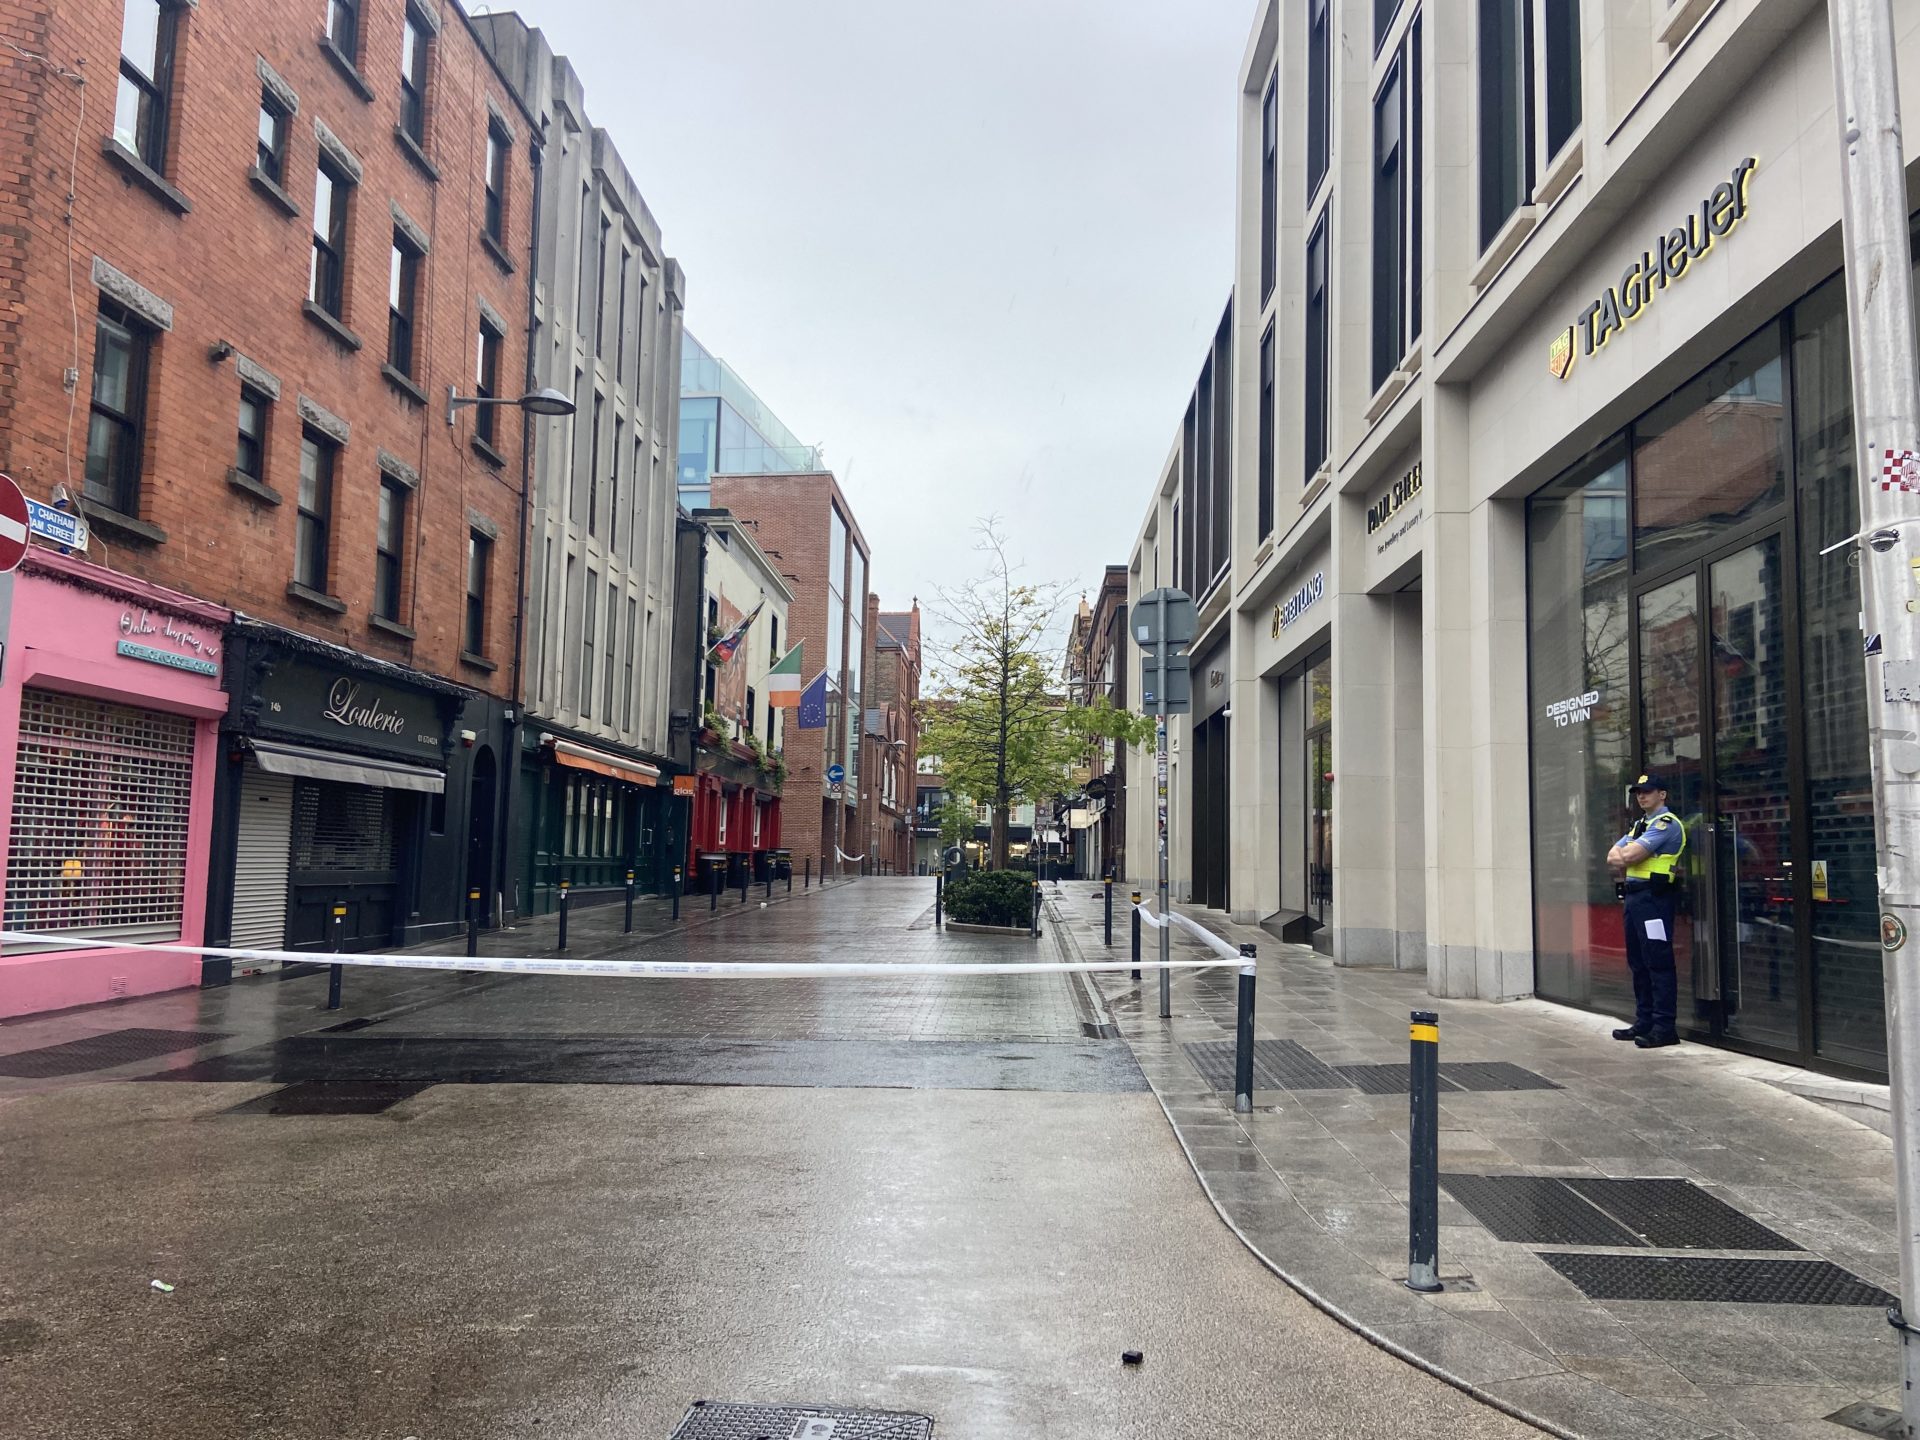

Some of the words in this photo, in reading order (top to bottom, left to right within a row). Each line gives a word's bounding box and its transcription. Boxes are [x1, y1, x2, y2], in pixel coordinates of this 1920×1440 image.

[38, 508, 75, 529] CHATHAM
[1368, 493, 1393, 535] PAUL
[46, 523, 74, 542] STREET
[78, 527, 85, 542] 2
[1280, 571, 1324, 630] BREITLING
[323, 677, 405, 735] Loulerie
[1546, 690, 1599, 718] DESIGNED
[1553, 713, 1568, 728] TO
[1570, 706, 1591, 724] WIN
